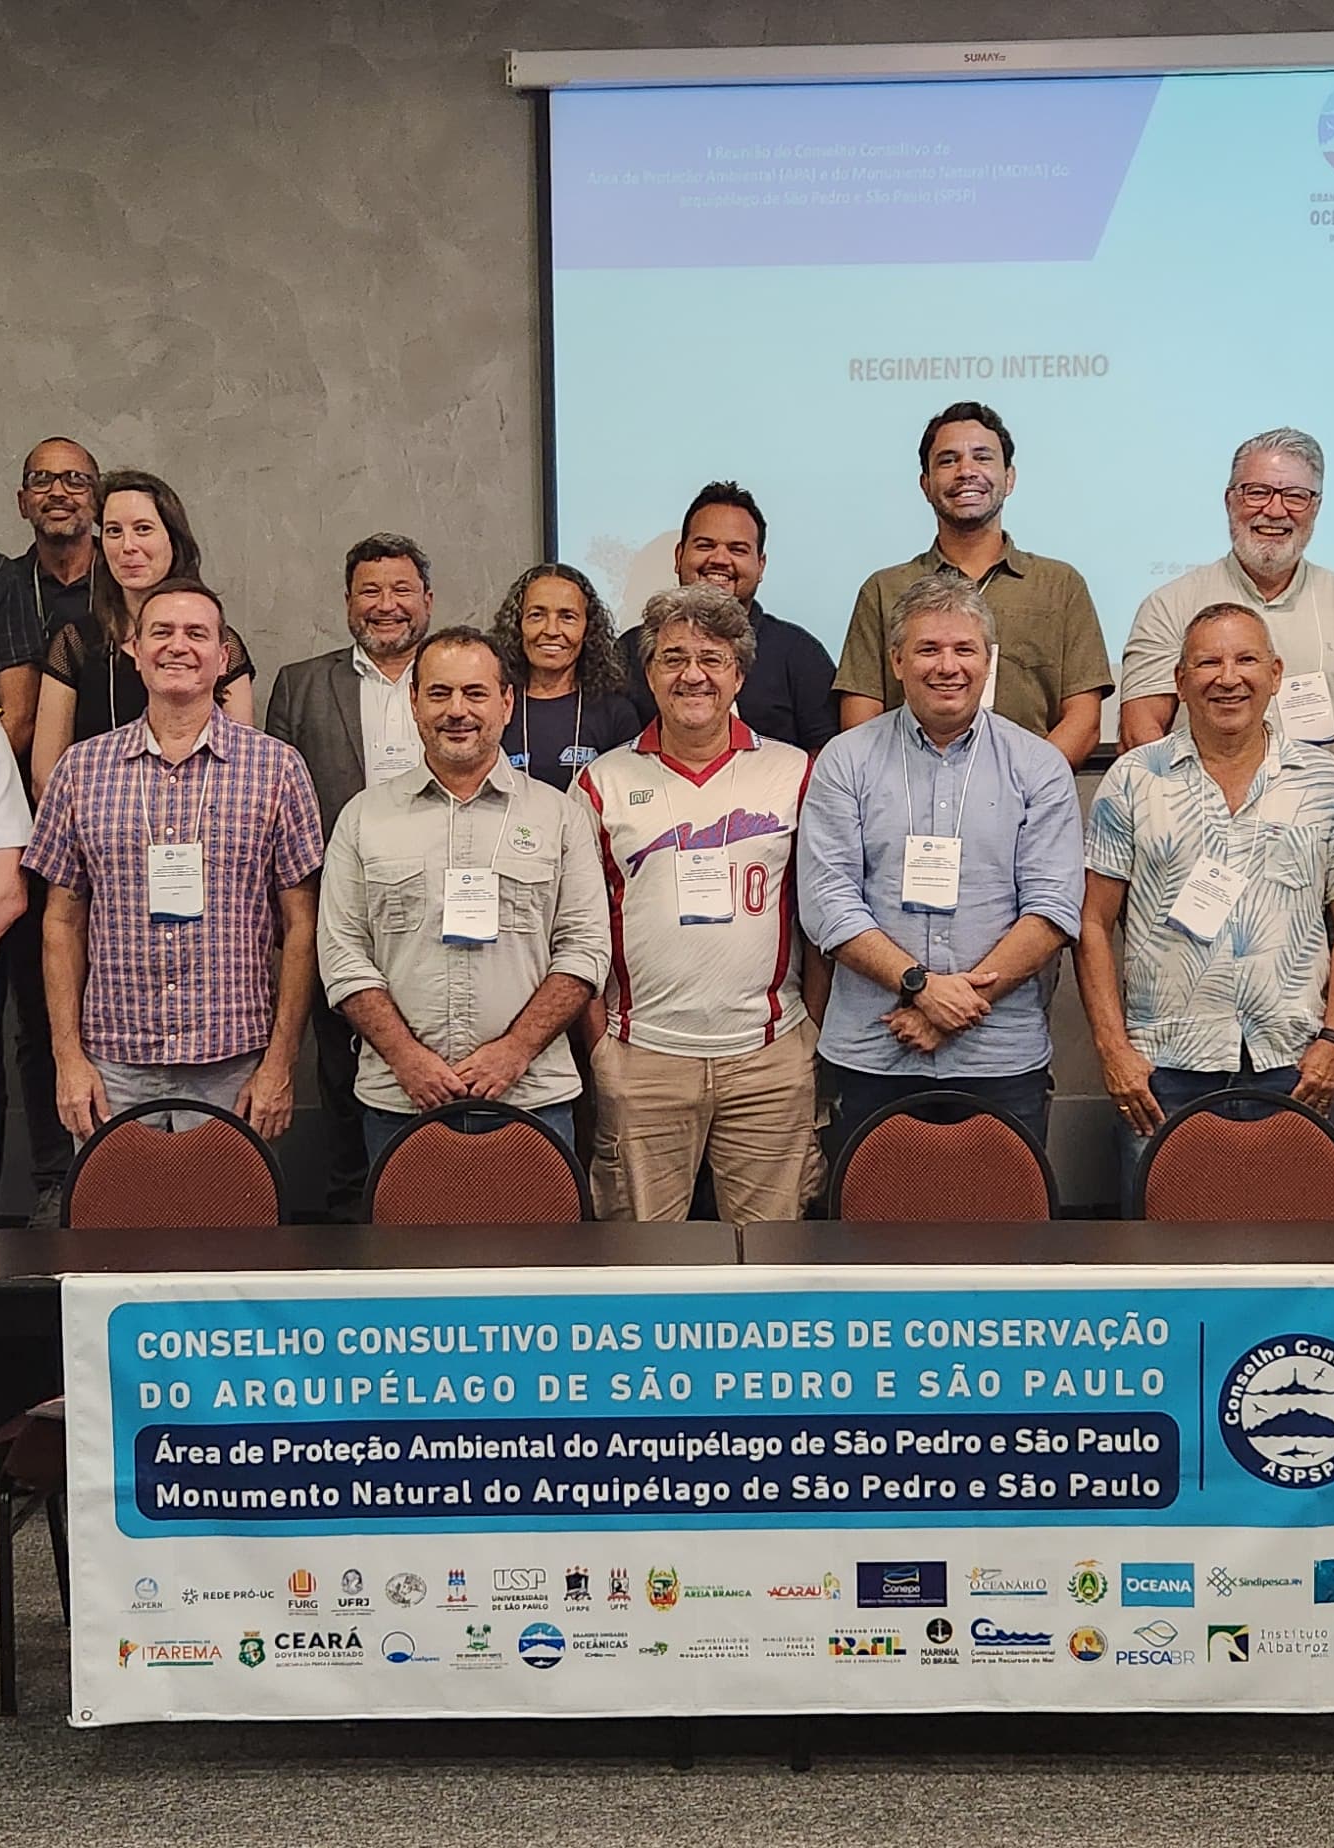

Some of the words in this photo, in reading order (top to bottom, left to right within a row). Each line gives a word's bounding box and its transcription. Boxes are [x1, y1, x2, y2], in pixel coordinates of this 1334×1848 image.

[849, 356, 994, 382] REGIMENTO
[1002, 354, 1109, 378] INTERNO
[138, 1329, 324, 1359] CONSELHO
[338, 1325, 557, 1354] CONSULTIVO
[572, 1324, 641, 1350] DAS
[655, 1321, 834, 1349] UNIDADES
[848, 1321, 891, 1347] DE
[905, 1312, 1168, 1350] CONSERVAÇÃO
[140, 1383, 190, 1408] DO
[214, 1371, 514, 1407] ARQUIPÉLAGO
[539, 1375, 587, 1401] DE
[611, 1367, 691, 1400] SÃO
[716, 1372, 852, 1399] PEDRO
[877, 1372, 895, 1397] E
[920, 1364, 1000, 1397] SÃO
[1025, 1369, 1163, 1396] PAULO
[1224, 1344, 1286, 1425] Conselho
[155, 1434, 220, 1463] Área
[230, 1440, 263, 1464] de
[273, 1436, 400, 1465] Proteção
[409, 1435, 555, 1459] Ambiental
[564, 1434, 597, 1457] do
[607, 1432, 782, 1461] Arquipélago
[792, 1432, 825, 1454] de
[834, 1431, 886, 1454] São
[897, 1430, 980, 1453] Pedro
[991, 1436, 1006, 1452] e
[1016, 1429, 1068, 1452] São
[1079, 1429, 1159, 1452] Paulo
[1262, 1461, 1334, 1484] ASPSP
[157, 1484, 339, 1507] Monumento
[353, 1480, 471, 1504] Natural
[485, 1480, 520, 1502] do
[533, 1477, 729, 1507] Arquipélago
[744, 1477, 779, 1499] de
[793, 1476, 848, 1499] São
[863, 1475, 955, 1498] Pedro
[970, 1481, 985, 1497] e
[999, 1474, 1055, 1497] São
[1071, 1474, 1159, 1496] Paulo
[493, 1568, 547, 1591] USP
[1126, 1578, 1192, 1593] OCEANA
[203, 1591, 230, 1600] REDE
[234, 1588, 274, 1599] PRÓ-UC
[491, 1594, 548, 1602] UNIVERSIDADE
[288, 1600, 318, 1609] FURG
[338, 1598, 370, 1607] UFRJ
[491, 1603, 501, 1611] DE
[504, 1601, 520, 1610] SÃO
[522, 1602, 548, 1610] PAULO
[275, 1627, 363, 1649] CEARÁ
[1261, 1630, 1328, 1639] Instituto
[573, 1639, 628, 1649] OCEÂNICAS
[828, 1637, 907, 1655] BRASIL
[1258, 1642, 1328, 1653] Albatroz
[142, 1645, 222, 1660] ITAREMA
[921, 1649, 959, 1657] MARINHA
